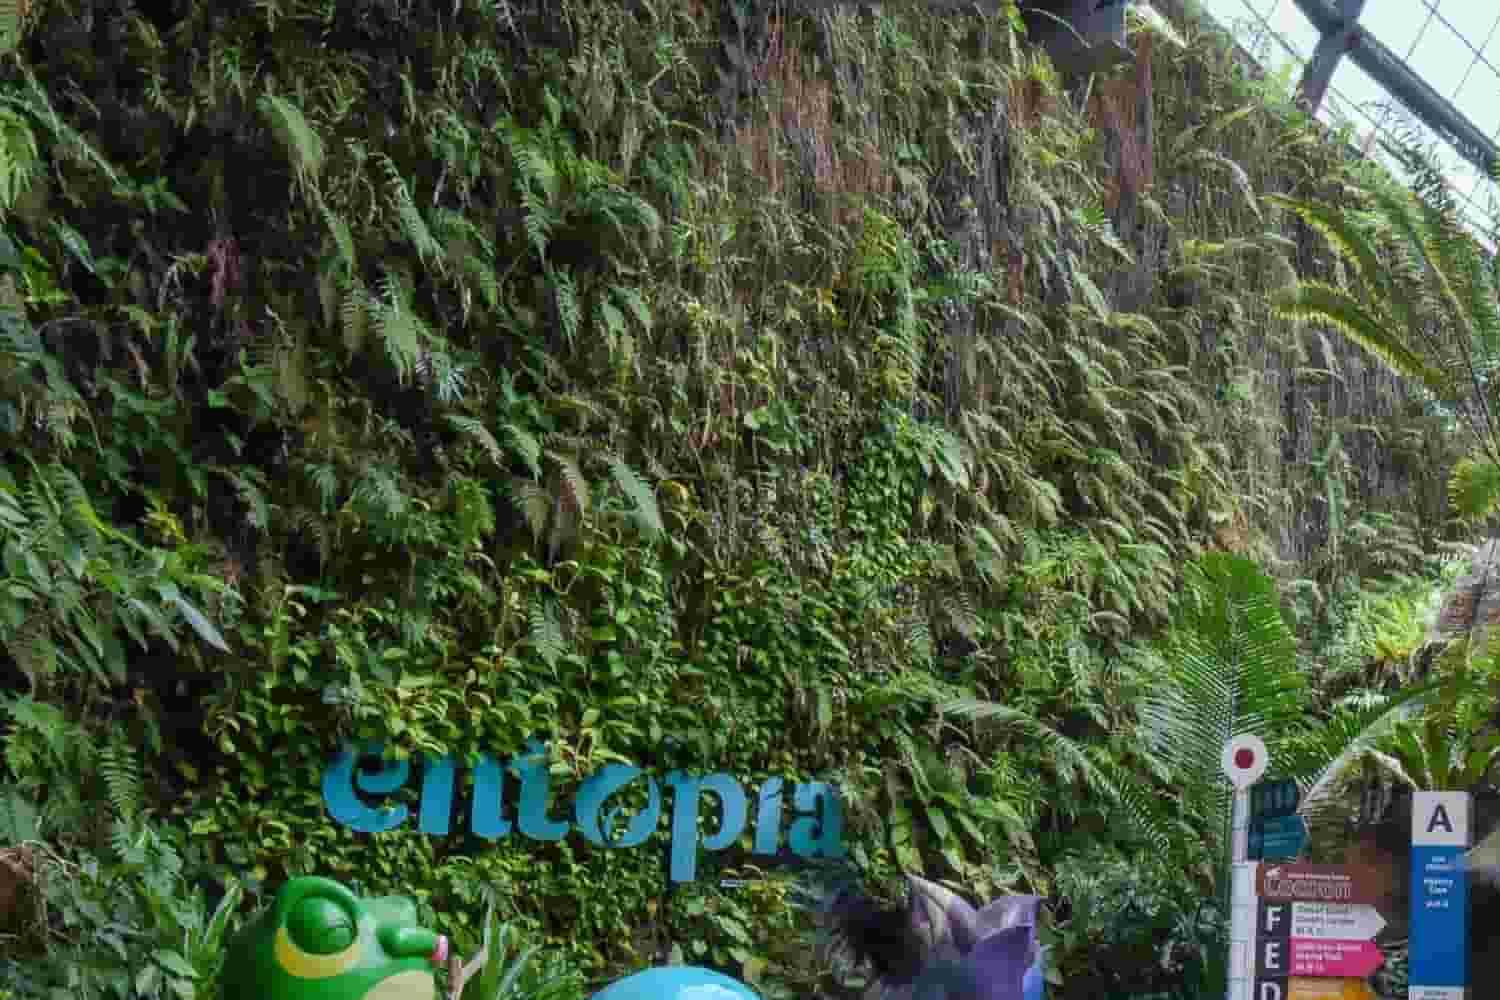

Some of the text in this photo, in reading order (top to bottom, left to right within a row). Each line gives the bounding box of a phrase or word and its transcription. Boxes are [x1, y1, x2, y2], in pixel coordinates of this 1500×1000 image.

[322, 740, 845, 882] entopia
[1426, 803, 1454, 832] A
[1266, 905, 1281, 931] F
[1265, 943, 1280, 969] E
